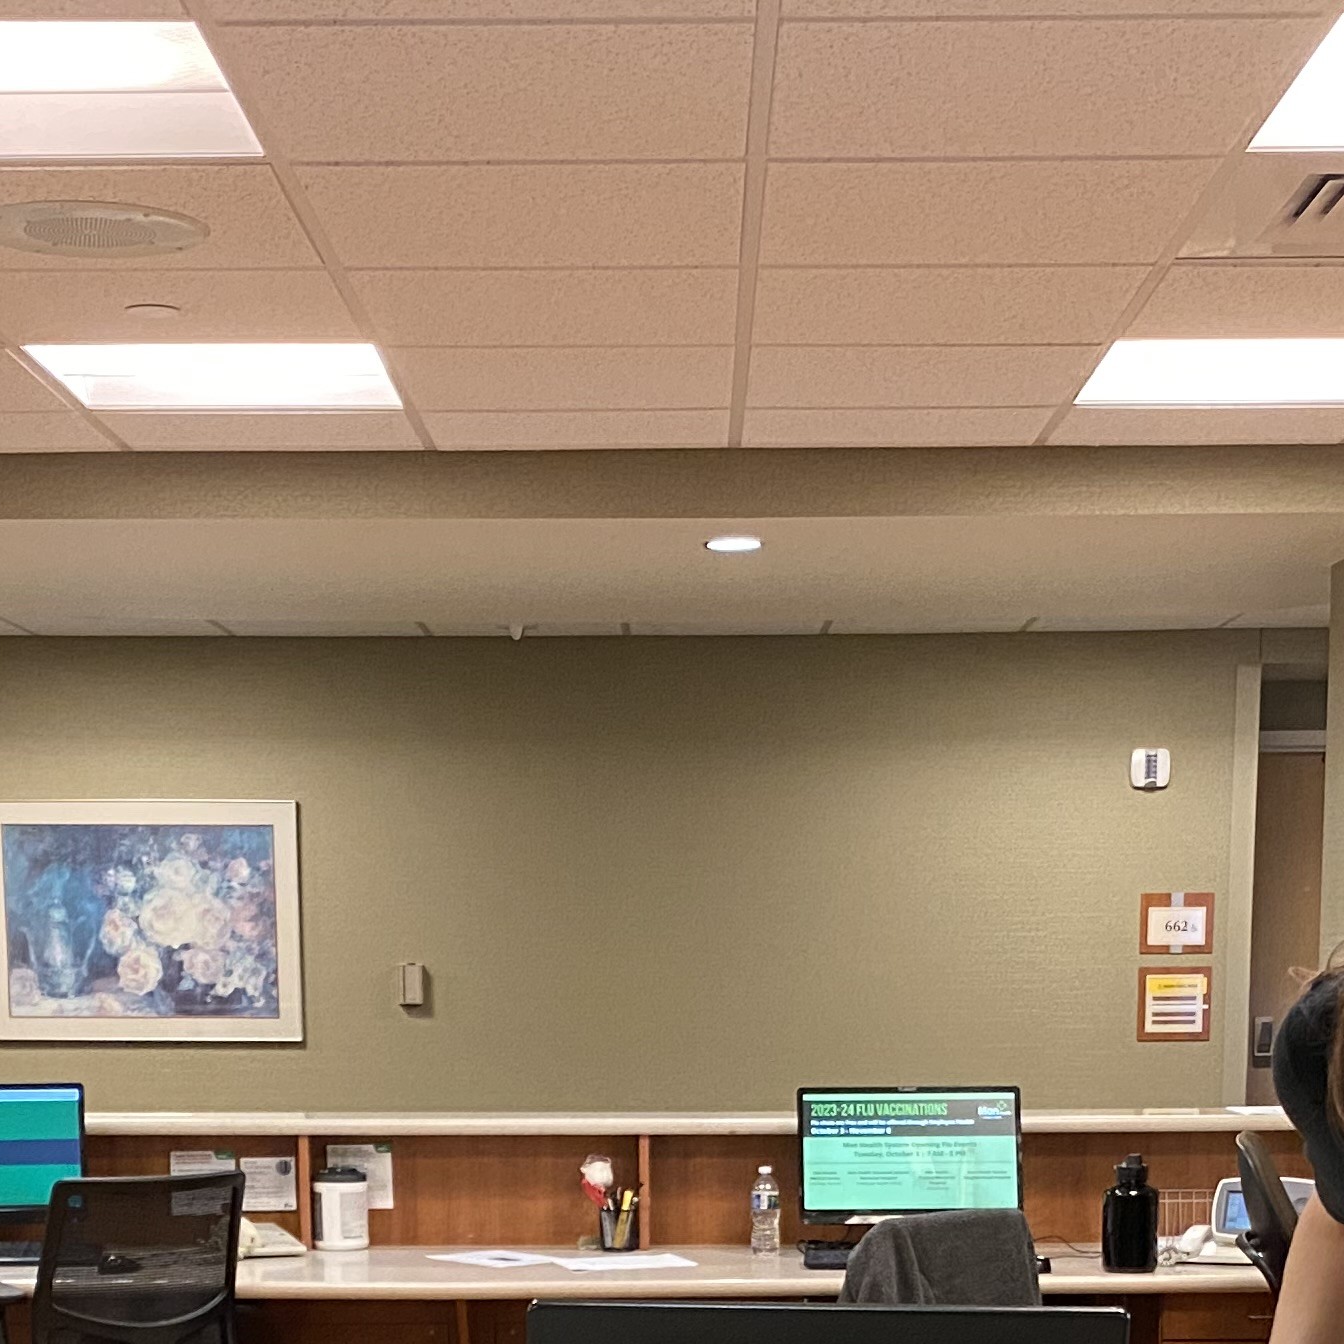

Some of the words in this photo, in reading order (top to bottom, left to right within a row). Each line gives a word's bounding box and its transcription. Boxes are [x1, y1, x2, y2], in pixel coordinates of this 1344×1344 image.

[1165, 920, 1188, 932] 662
[811, 1103, 855, 1116] 2023-24
[857, 1103, 875, 1116] FLU
[876, 1103, 948, 1116] VACCINATIONS
